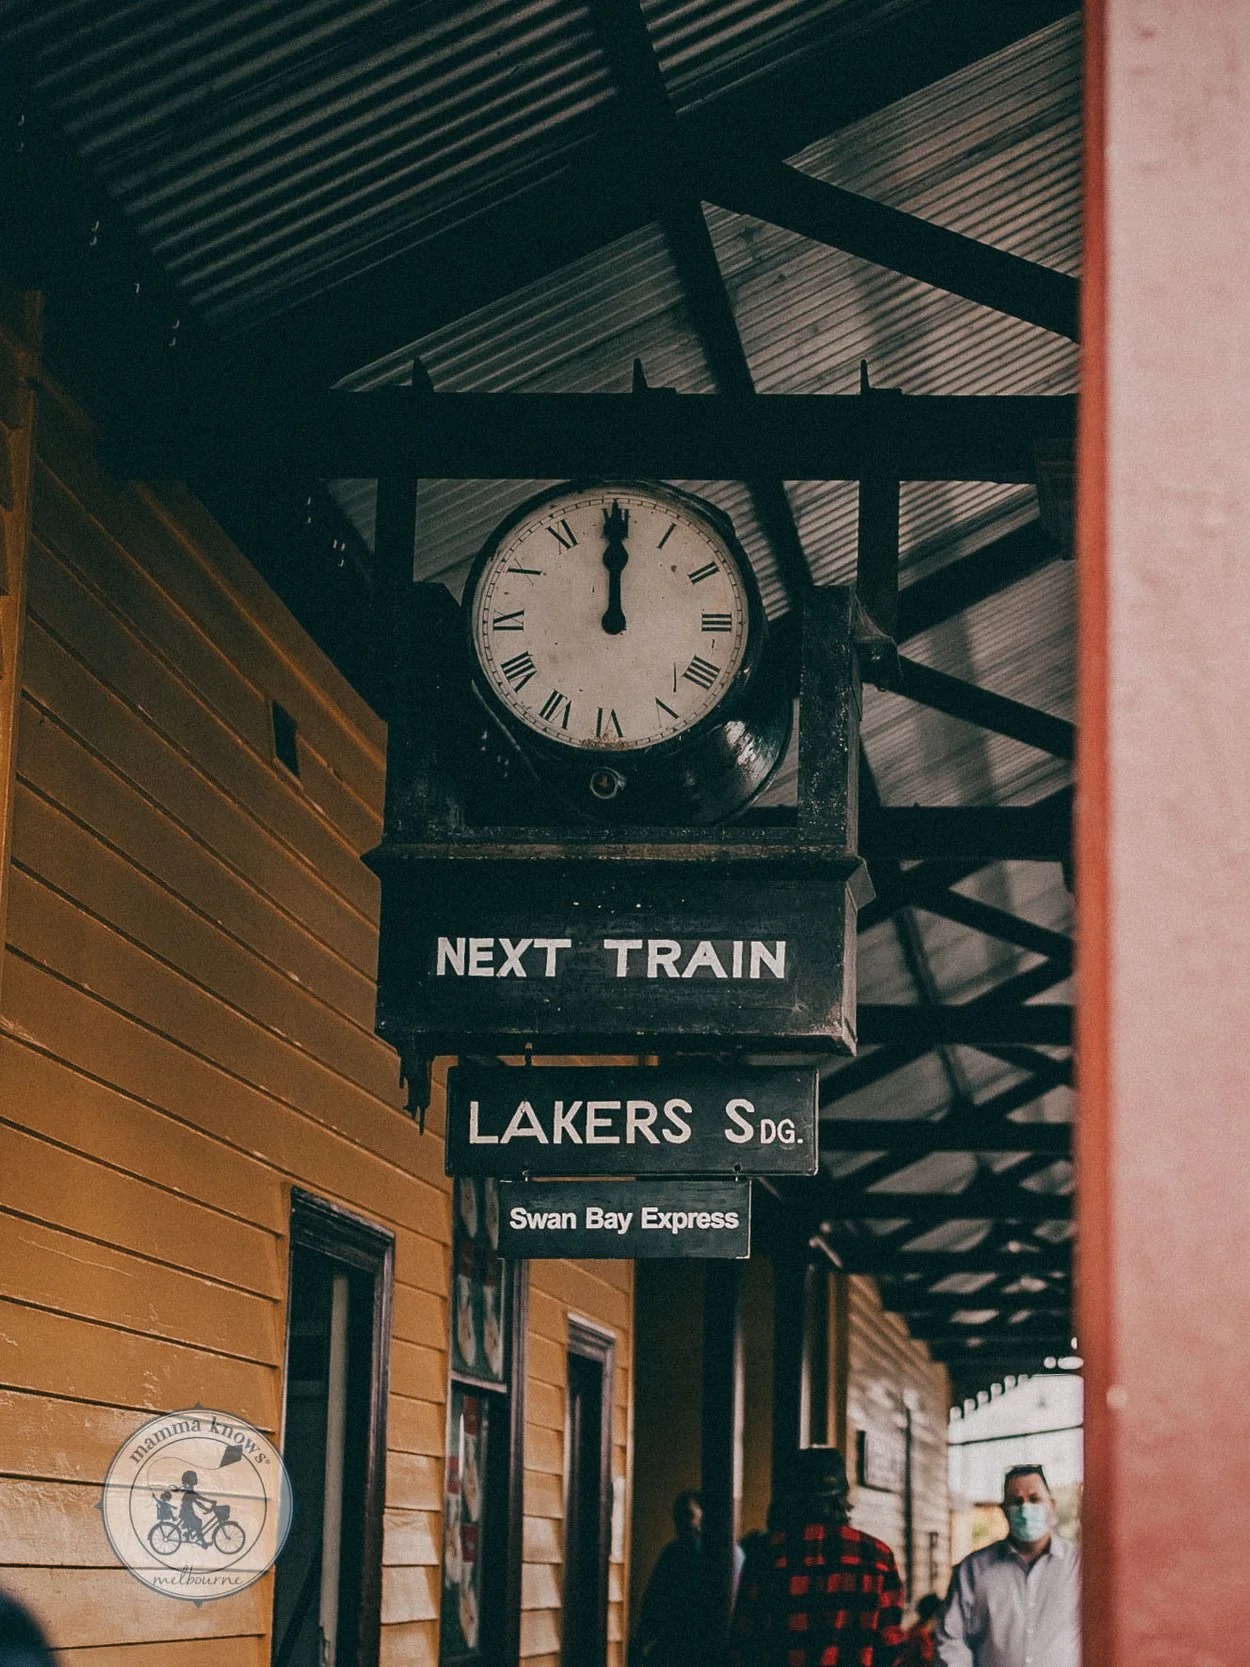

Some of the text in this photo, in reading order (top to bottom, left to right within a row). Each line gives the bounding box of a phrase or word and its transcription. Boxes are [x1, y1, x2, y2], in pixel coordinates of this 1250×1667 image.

[687, 560, 721, 585] II
[702, 613, 732, 632] III
[500, 650, 537, 693] VIII
[682, 654, 721, 690] IIII
[436, 936, 787, 979] NEXT TRAIN
[469, 1098, 693, 1145] LAKERS
[509, 1206, 740, 1235] Swan Bay Express
